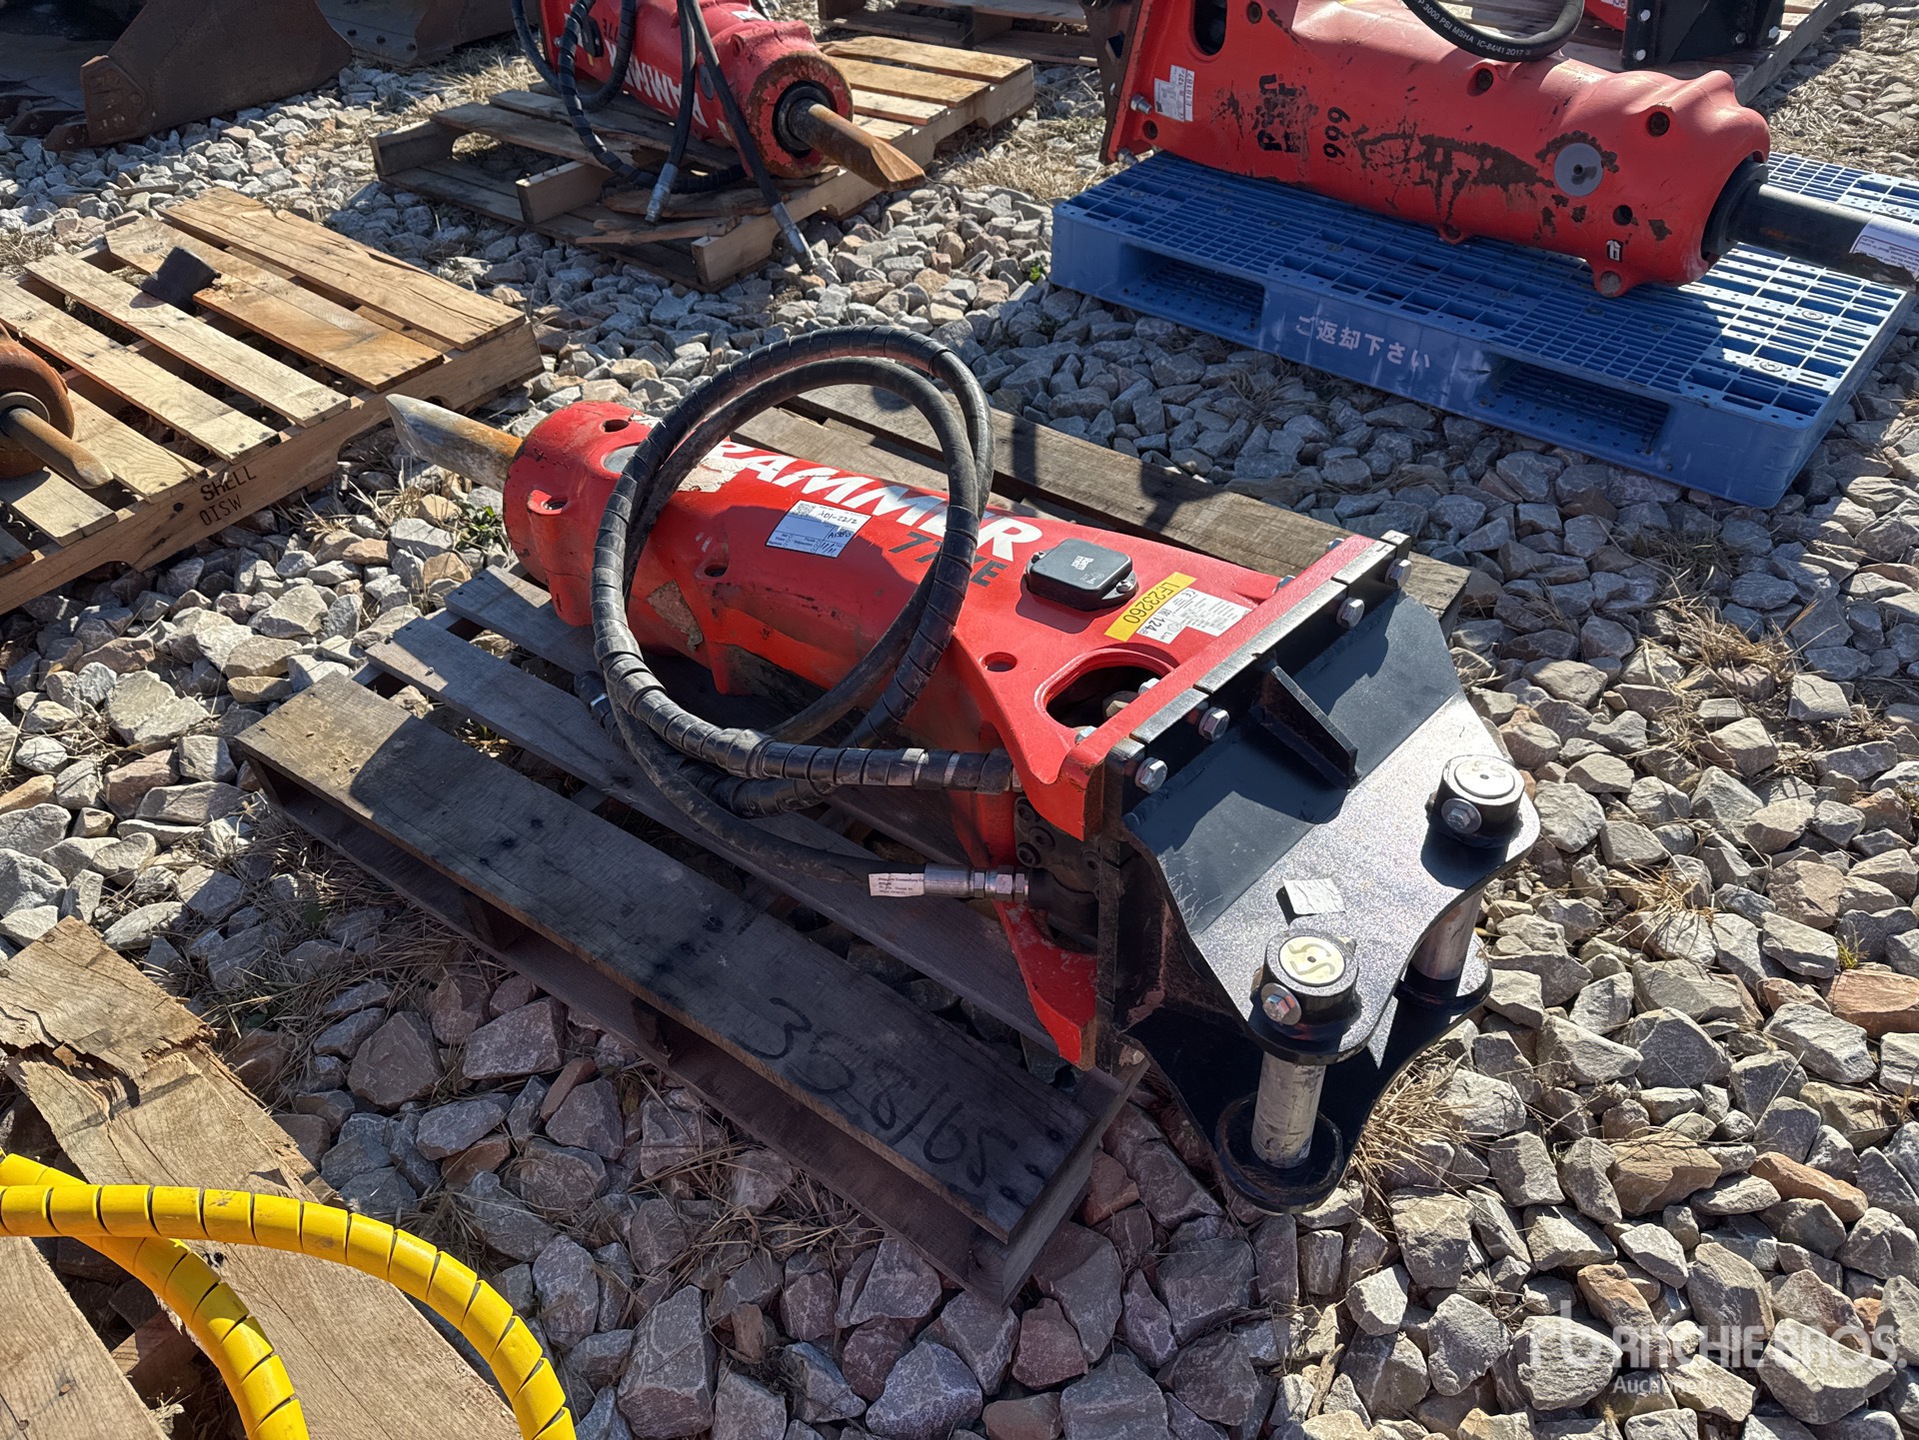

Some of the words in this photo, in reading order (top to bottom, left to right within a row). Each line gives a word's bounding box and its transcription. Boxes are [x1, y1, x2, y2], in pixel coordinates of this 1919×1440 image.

[1423, 3, 1440, 20] 3000
[1439, 17, 1453, 30] PSI
[1452, 25, 1474, 43] MSHA
[605, 38, 709, 129] RAMMR
[1295, 314, 1431, 369] ご返却下さい
[200, 465, 257, 502] SHELL
[1123, 581, 1180, 625] LF23260
